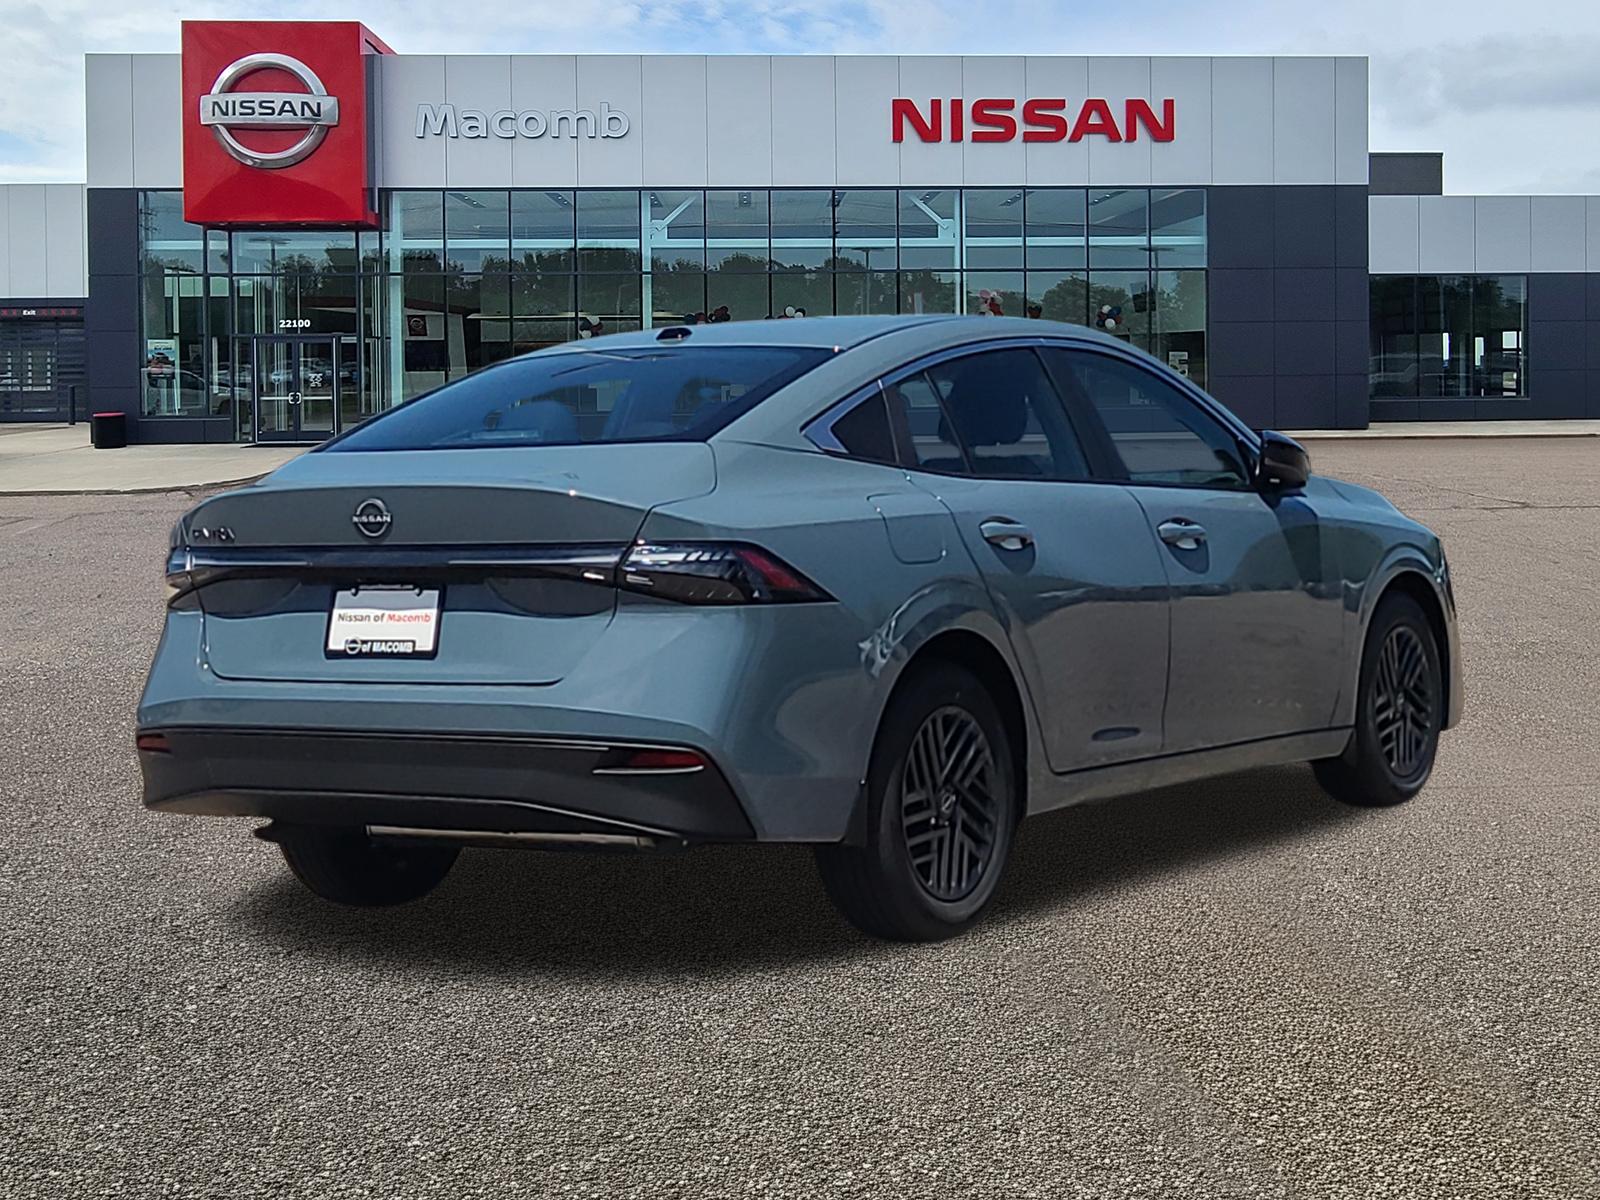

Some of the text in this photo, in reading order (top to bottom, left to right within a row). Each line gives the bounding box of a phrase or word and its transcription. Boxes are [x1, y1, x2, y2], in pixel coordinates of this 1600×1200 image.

[211, 100, 322, 117] NISSAN
[415, 101, 630, 138] Macomb
[891, 98, 1175, 143] NISSAN
[279, 319, 311, 328] 22100
[352, 513, 391, 523] NISSAN
[338, 613, 431, 623] Nissan of Macomb
[361, 641, 414, 653] of MACOMB
